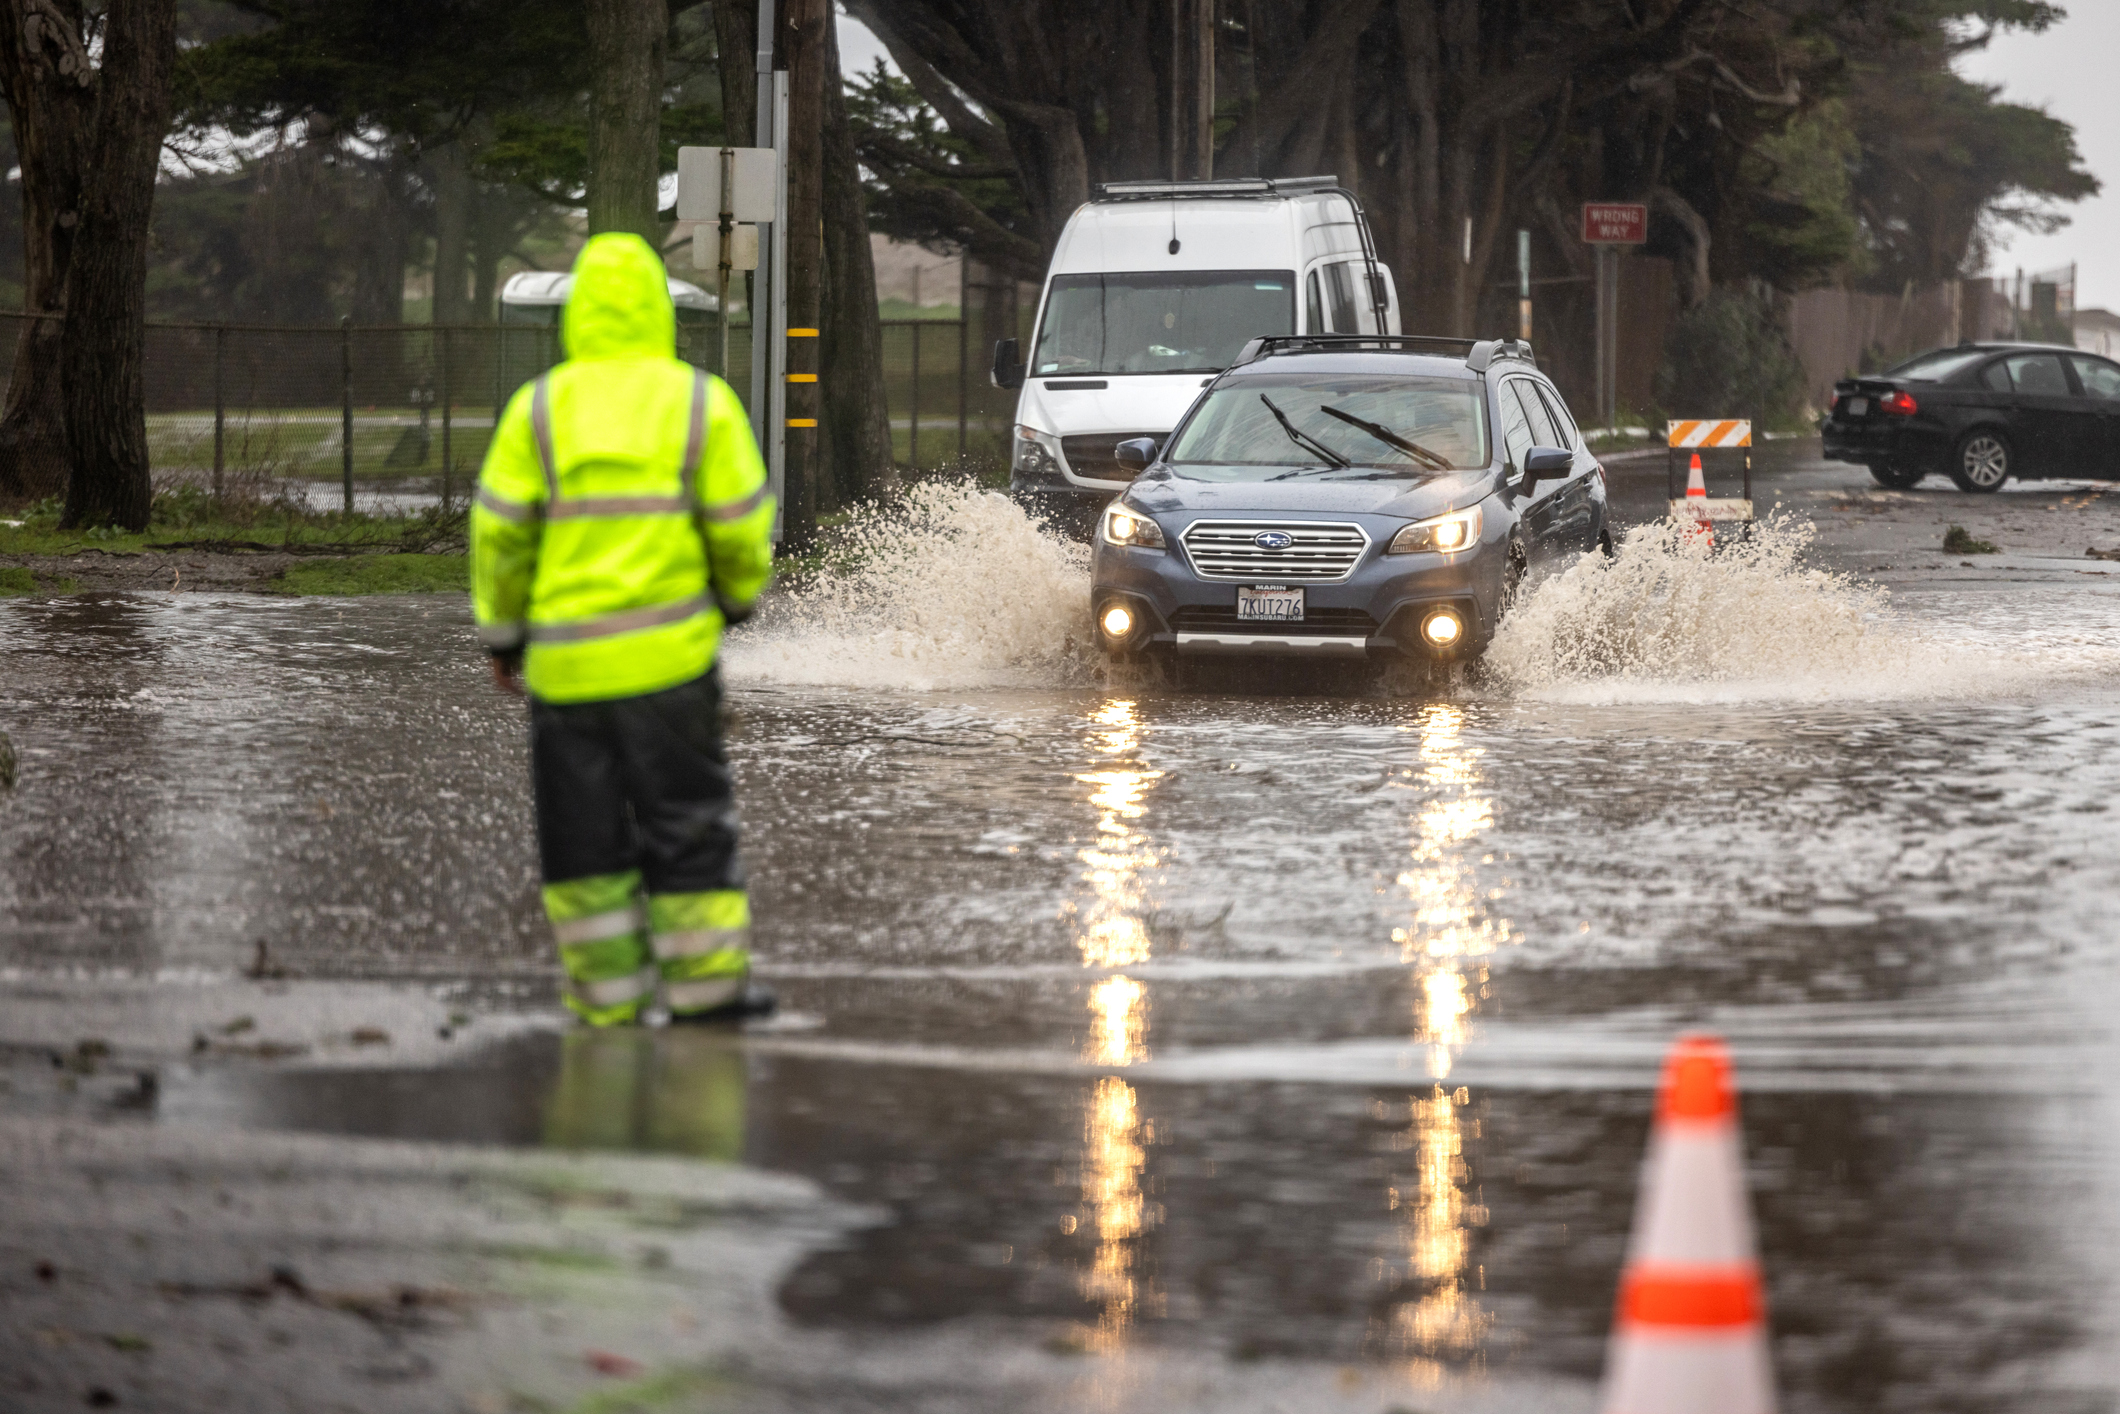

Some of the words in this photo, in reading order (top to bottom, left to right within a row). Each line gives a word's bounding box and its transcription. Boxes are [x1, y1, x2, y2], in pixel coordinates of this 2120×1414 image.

[1591, 210, 1639, 223] WRONG
[1600, 225, 1629, 238] WAY
[1241, 598, 1301, 616] 7KUT276
